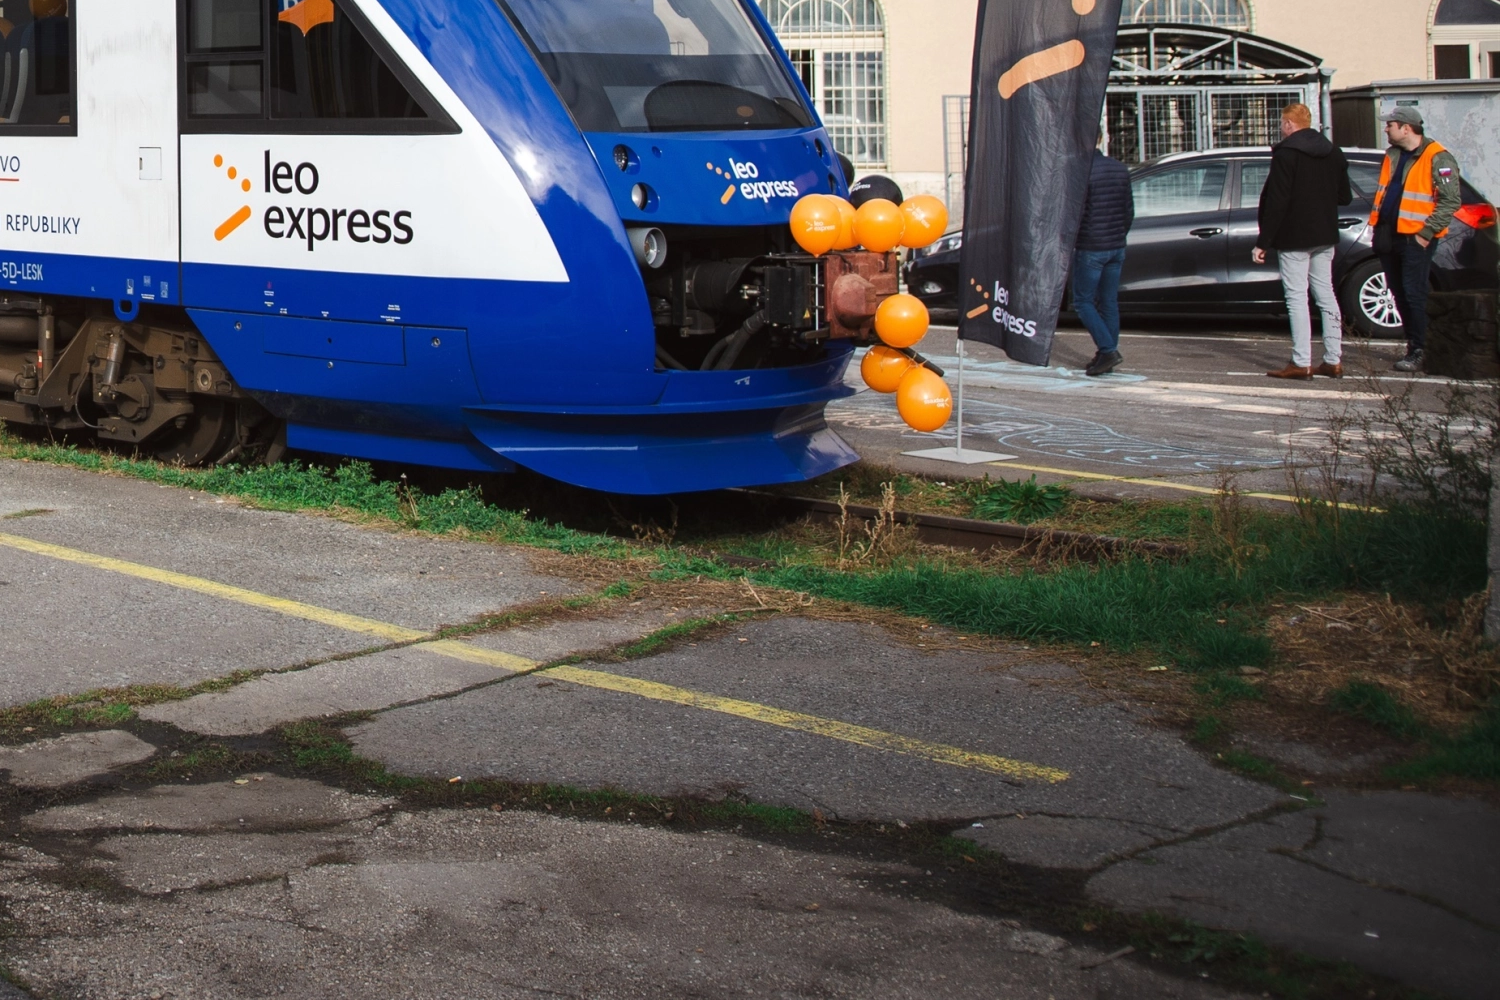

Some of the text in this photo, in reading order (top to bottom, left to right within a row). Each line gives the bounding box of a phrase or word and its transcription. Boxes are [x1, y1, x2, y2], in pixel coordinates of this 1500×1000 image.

[264, 149, 319, 195] leo
[729, 157, 759, 180] leo
[740, 180, 799, 204] express
[6, 214, 81, 235] REPUBLIKY
[263, 205, 414, 252] express
